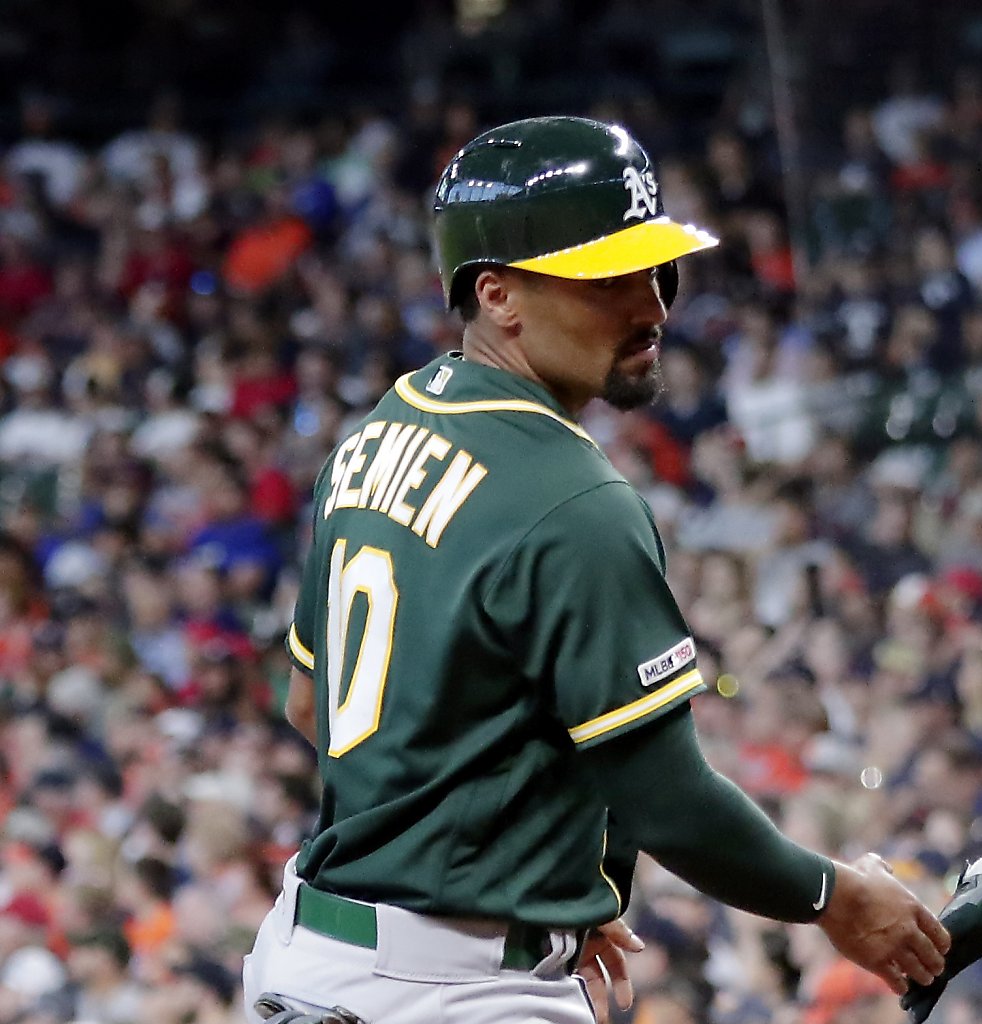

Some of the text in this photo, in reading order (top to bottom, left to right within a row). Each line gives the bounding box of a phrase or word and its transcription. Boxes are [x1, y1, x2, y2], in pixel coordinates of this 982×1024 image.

[622, 166, 658, 221] A's
[324, 420, 489, 549] SEMIEN
[326, 537, 399, 759] 10
